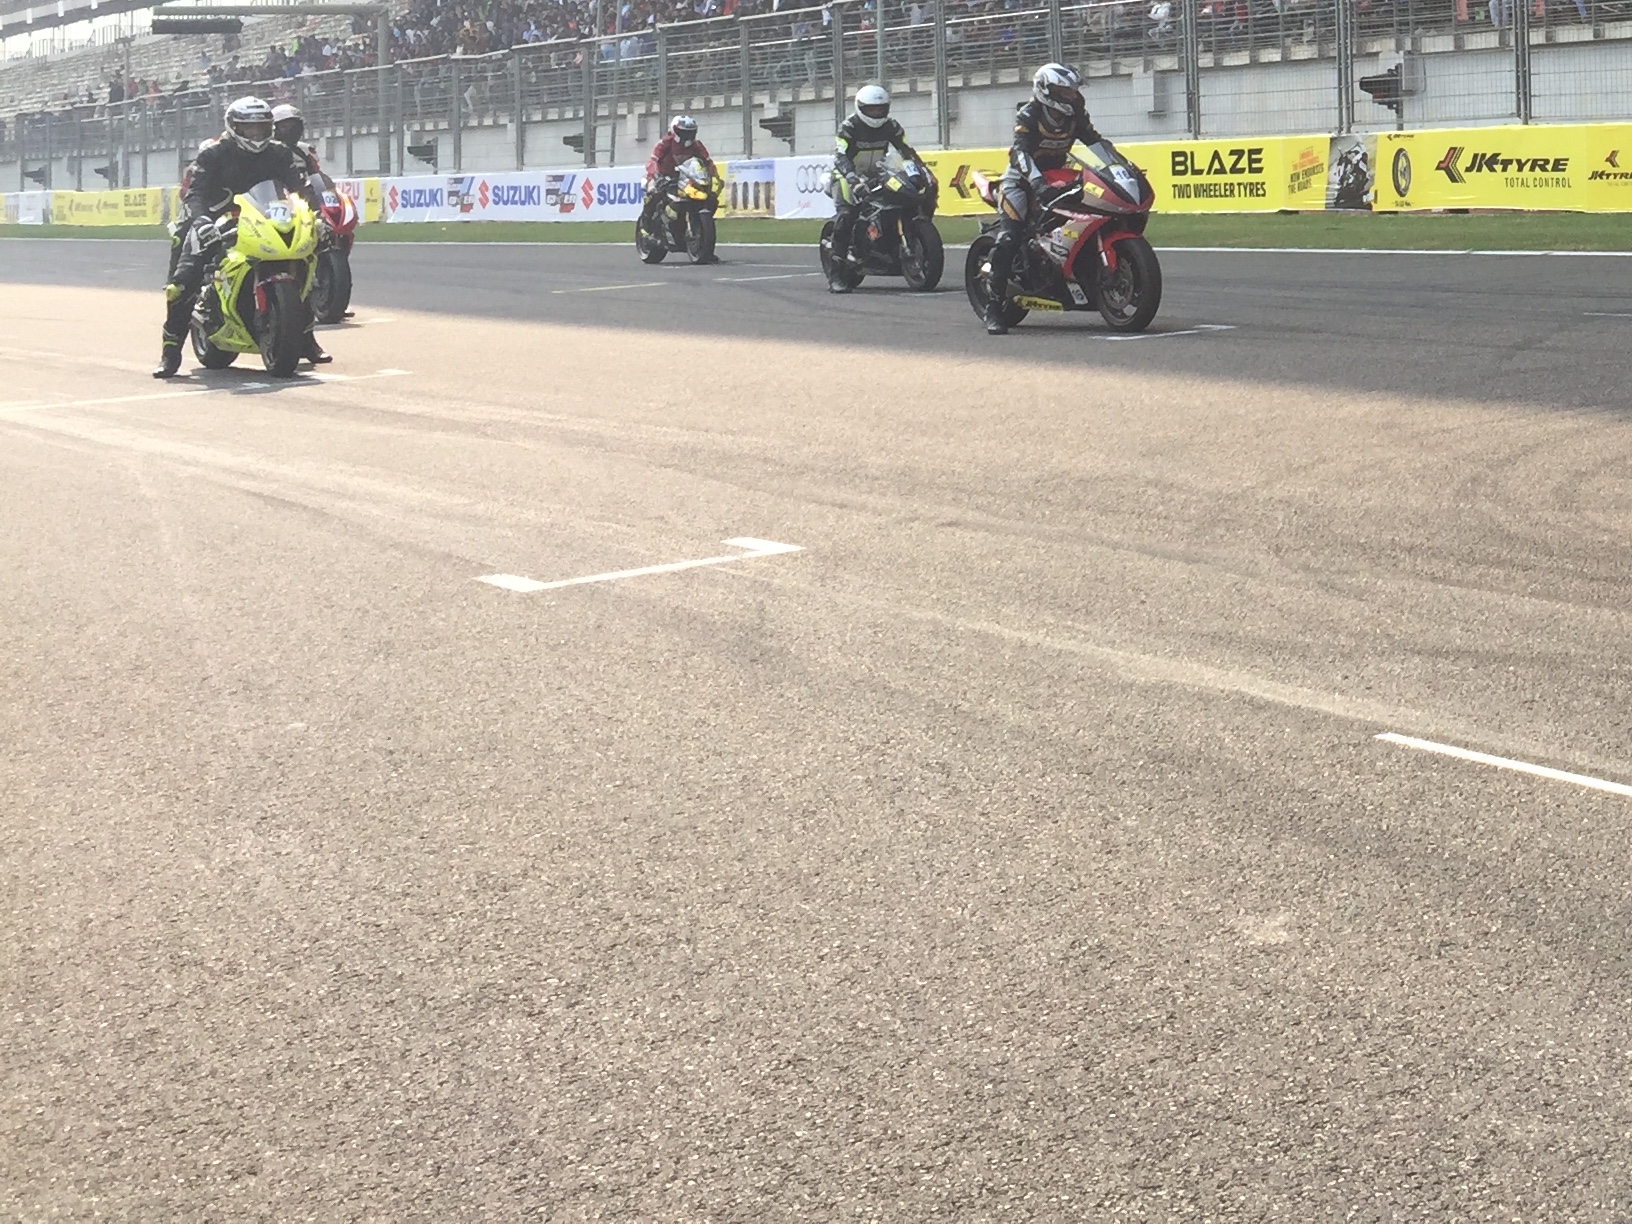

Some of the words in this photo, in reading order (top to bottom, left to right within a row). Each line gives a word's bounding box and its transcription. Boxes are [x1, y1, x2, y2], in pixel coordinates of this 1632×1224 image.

[1171, 147, 1265, 177] BLAZE
[596, 181, 646, 206] SUZUK
[1172, 183, 1192, 199] TWO
[1193, 182, 1236, 199] WHEELER
[1237, 181, 1267, 198] TYRES
[1504, 176, 1530, 189] TOTAL
[1532, 176, 1572, 189] CONTROL
[400, 187, 444, 209] SUZUKI
[492, 184, 541, 206] SUZUKI
[271, 206, 288, 218] 77
